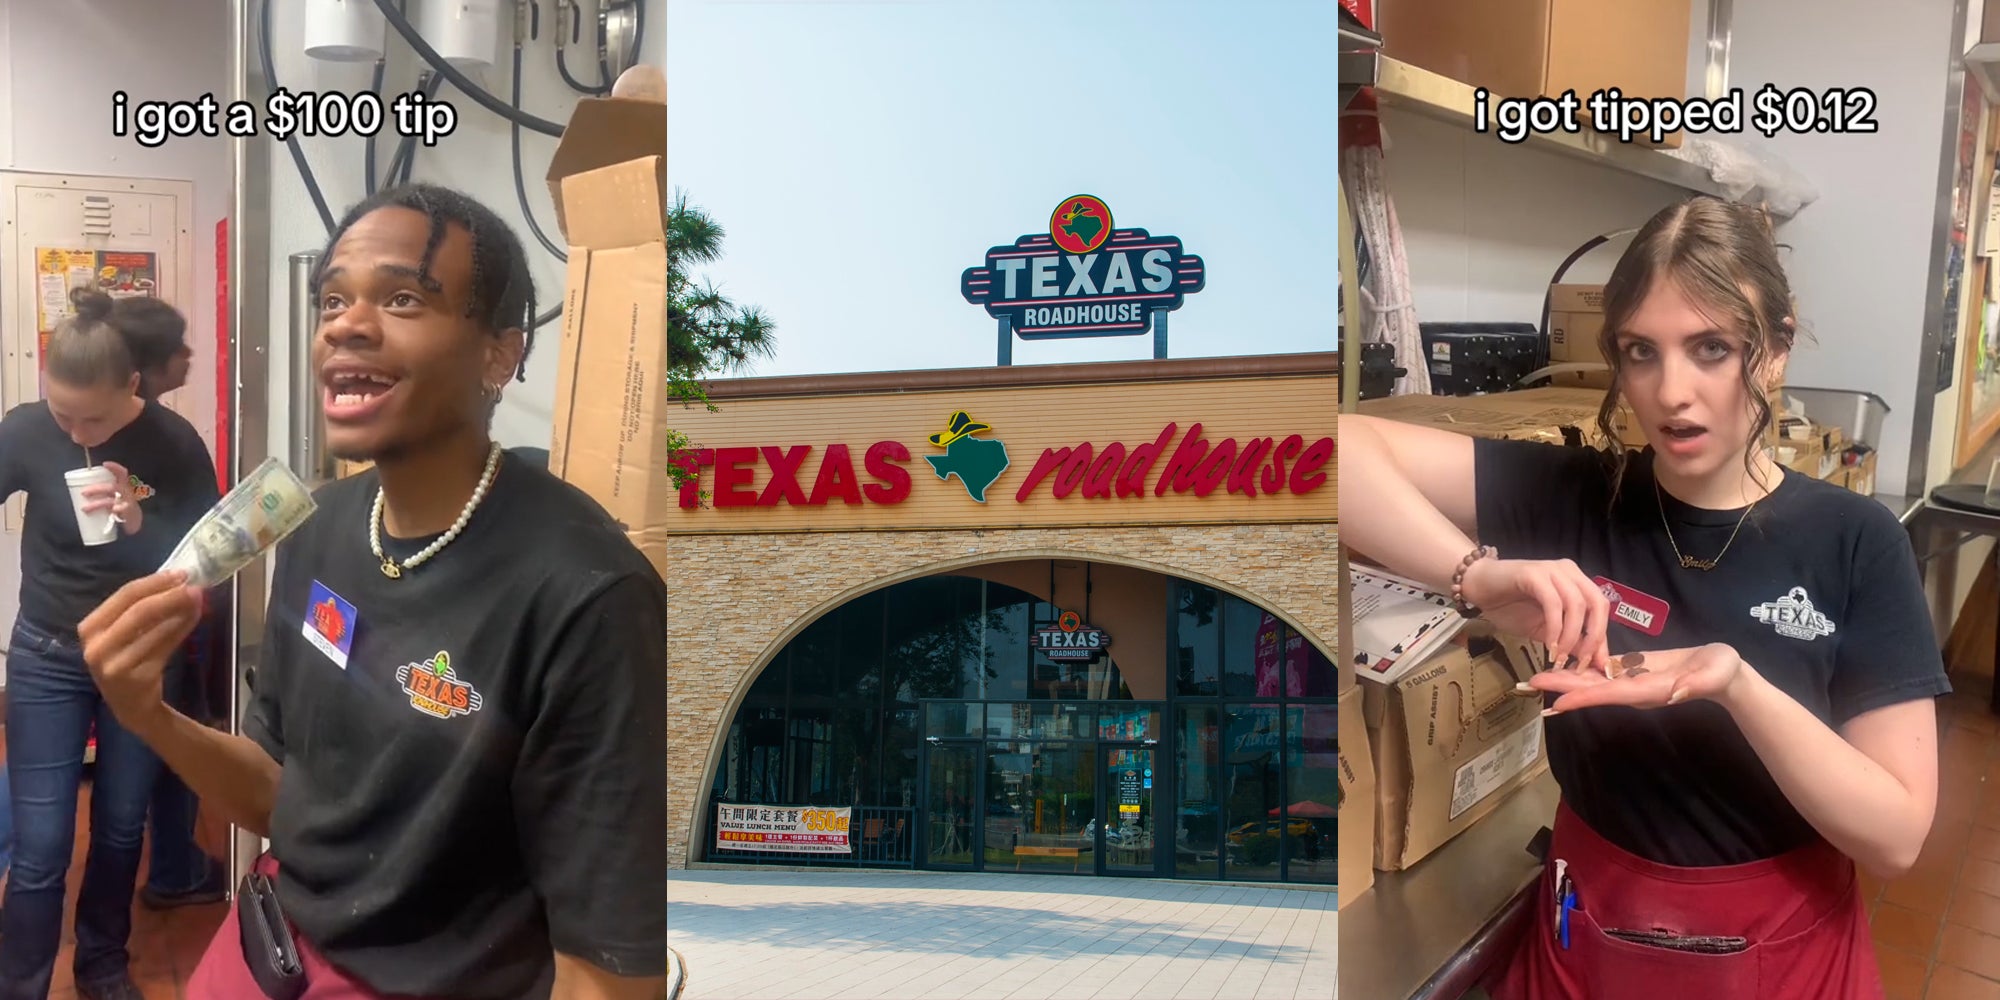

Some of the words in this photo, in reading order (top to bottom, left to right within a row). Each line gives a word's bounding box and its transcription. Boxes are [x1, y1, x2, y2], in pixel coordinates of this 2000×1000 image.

[996, 249, 1173, 299] TEXAS
[1024, 303, 1142, 326] ROADHOUSE
[668, 440, 912, 508] TEXAS
[1618, 603, 1651, 625] EMILY
[1766, 606, 1825, 631] TEXAS
[1040, 631, 1100, 647] TEXAS
[1049, 649, 1089, 657] ROADHOUSE
[409, 667, 468, 708] TEXAS
[1413, 665, 1448, 687] GALLONS
[1430, 685, 1439, 719] ASSIST
[1427, 721, 1435, 746] GRIP
[720, 807, 798, 823] 午間限定套餐
